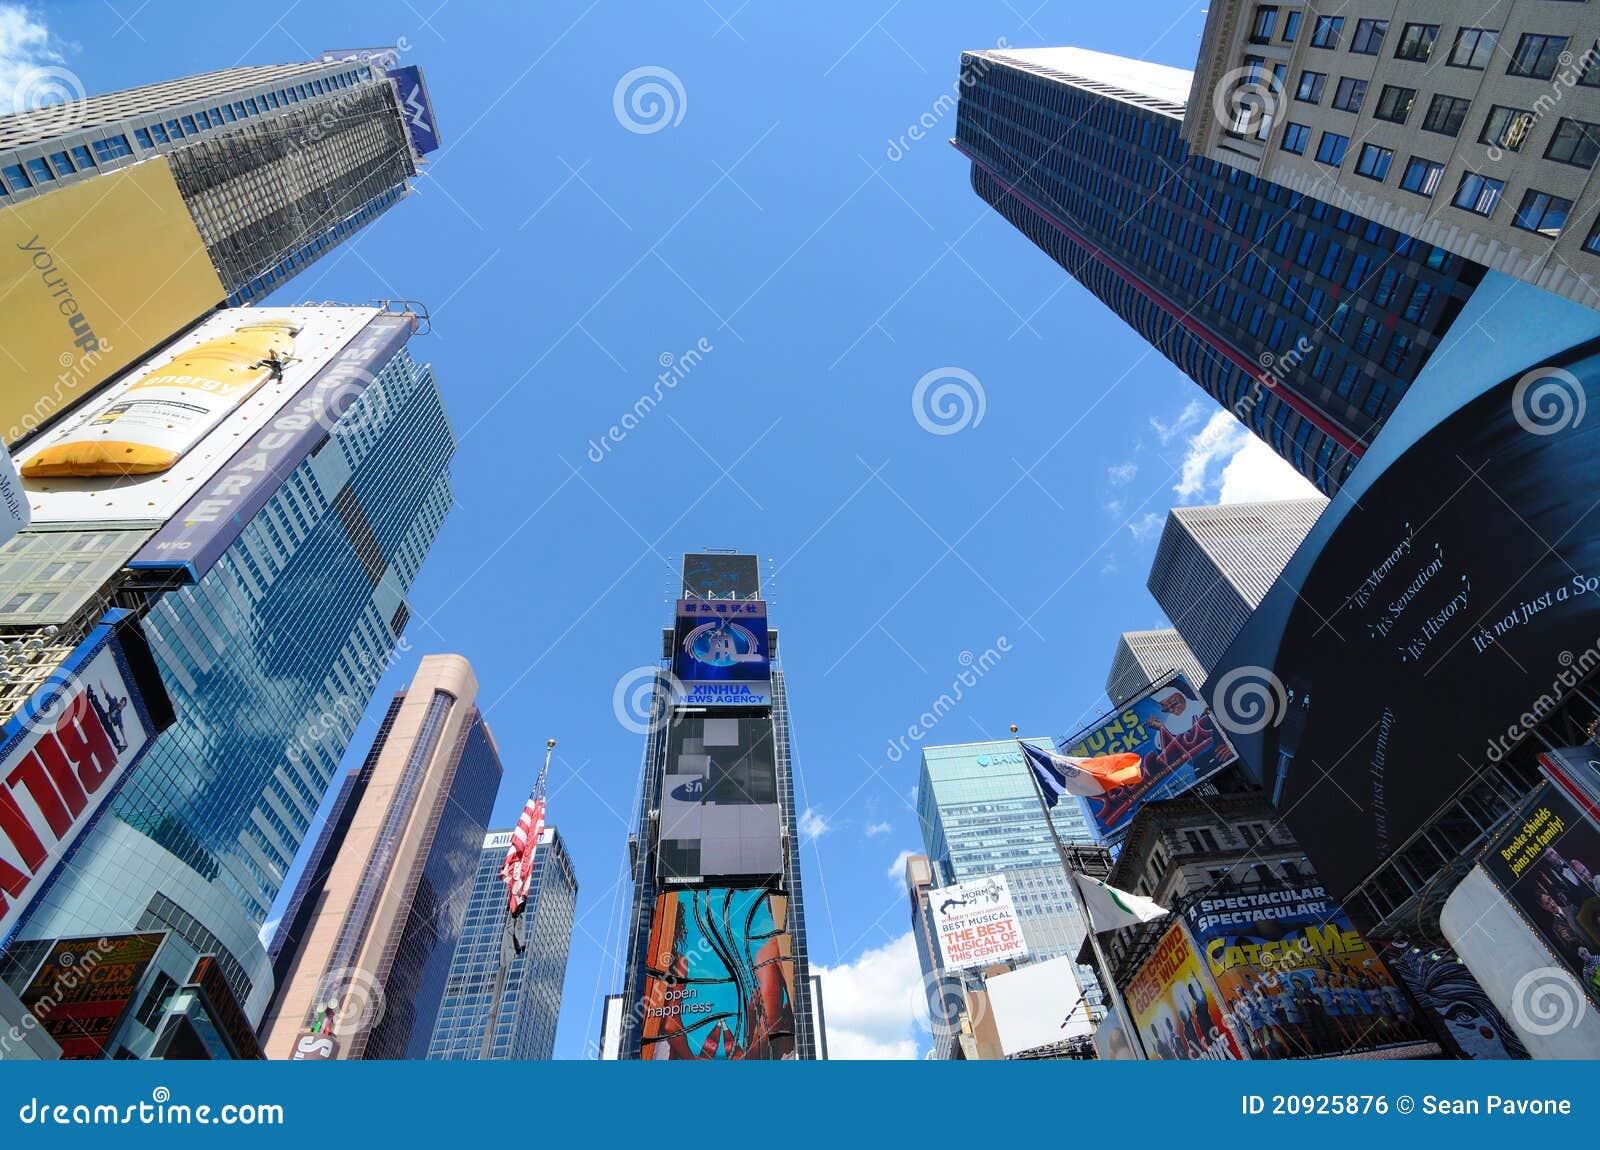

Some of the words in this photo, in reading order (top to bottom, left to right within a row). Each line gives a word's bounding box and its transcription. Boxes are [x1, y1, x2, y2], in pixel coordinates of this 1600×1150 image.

[143, 373, 237, 395] energy
[1388, 558, 1443, 618] Sensation
[1421, 591, 1468, 641] History
[1472, 630, 1495, 654] It's
[1494, 609, 1520, 636] not
[1520, 591, 1553, 625] just
[1556, 586, 1569, 601] a
[1572, 574, 1600, 595] So
[680, 695, 713, 703] NEWS
[716, 695, 764, 703] AGENCY
[693, 684, 751, 695] XINHUA
[1070, 709, 1140, 757] NUNS
[1501, 833, 1528, 861] Brooke
[1523, 807, 1551, 838] Shields
[1509, 854, 1530, 878] joins
[1526, 842, 1541, 858] the
[1536, 815, 1565, 847] family!
[943, 921, 965, 932] BEST
[968, 911, 1011, 926] MUSICAL
[976, 920, 1013, 937] BEST
[1198, 902, 1327, 932] SPECTACULAR!
[947, 935, 999, 954] MUSICAL
[1001, 931, 1017, 941] OF
[1304, 924, 1367, 957] ME
[950, 952, 972, 963] THIS
[1127, 970, 1150, 997] THE
[1149, 924, 1184, 978] CROWD
[664, 988, 697, 1001] open
[1135, 976, 1162, 1015] GOES
[647, 1002, 713, 1018] happiness
